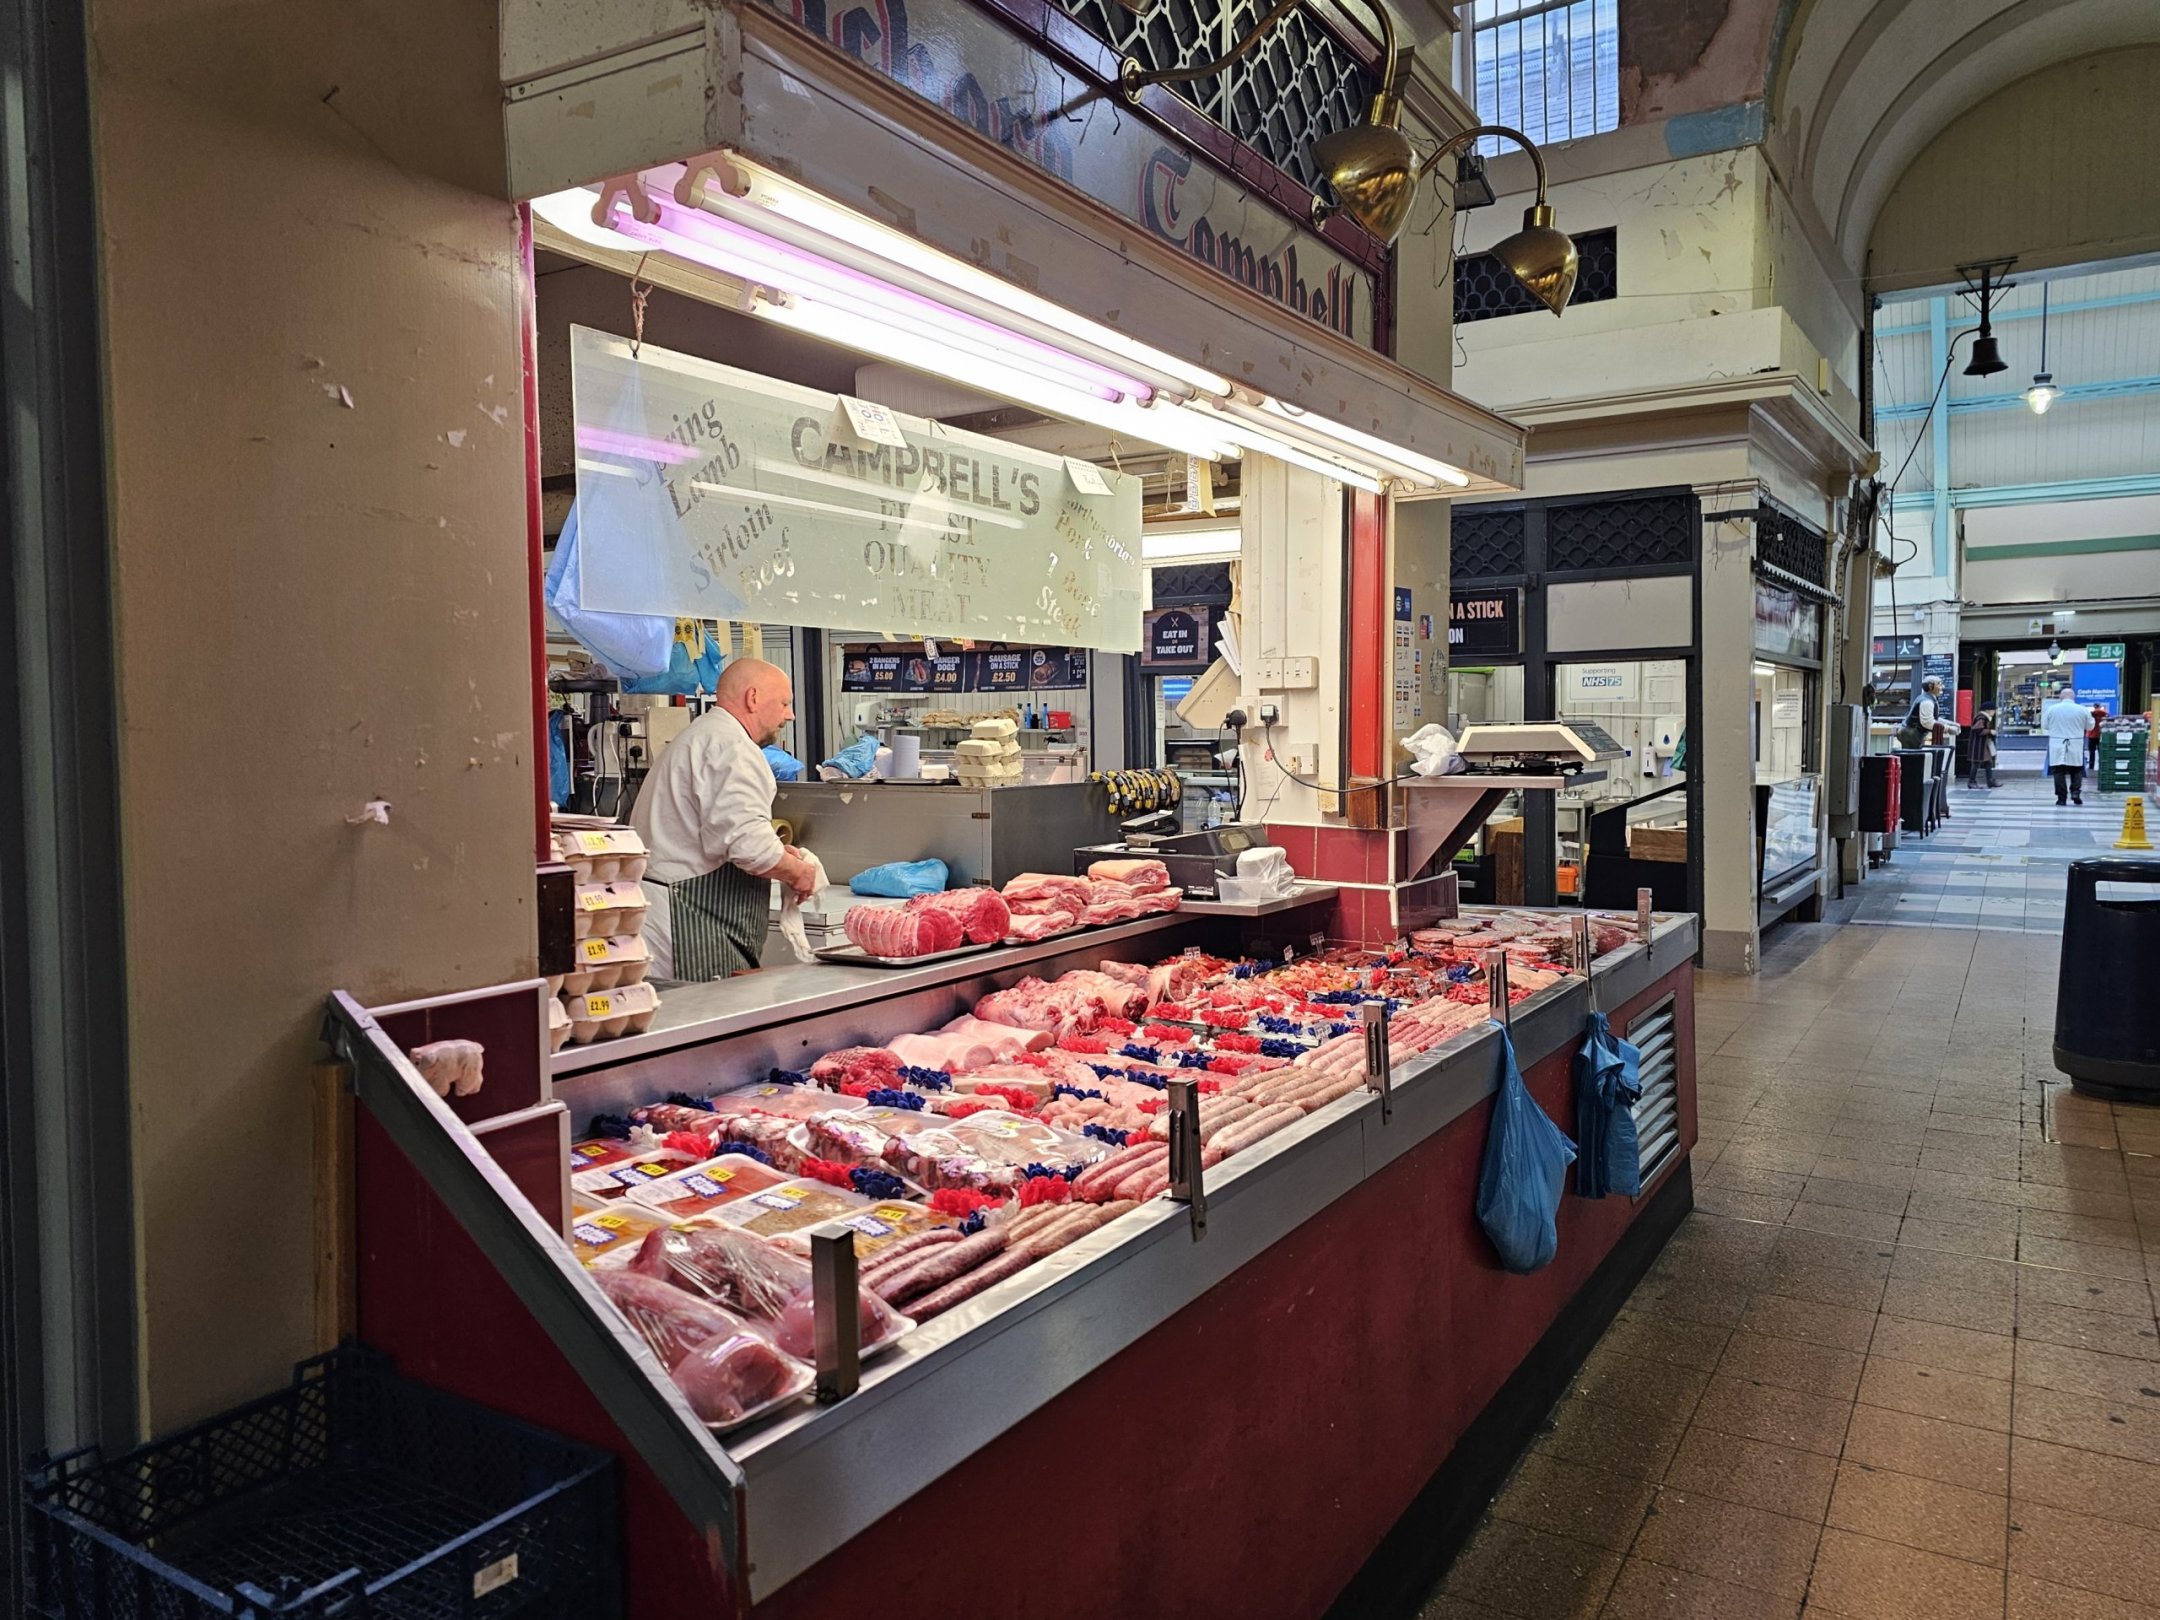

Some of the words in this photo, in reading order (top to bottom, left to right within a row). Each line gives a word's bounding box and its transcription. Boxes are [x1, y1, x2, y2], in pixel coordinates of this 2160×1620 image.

[636, 399, 723, 489] Spring
[790, 416, 1040, 516] CAMPBELL'S
[667, 434, 741, 520] Lamb
[879, 498, 978, 546] FIST
[690, 502, 774, 595] Sirloin
[1456, 602, 1465, 620] A
[1467, 600, 1504, 619] STICK
[1162, 630, 1178, 639] EAT
[1178, 630, 1188, 638] IN
[1156, 646, 1176, 654] TAKE
[1177, 645, 1194, 654] OUT
[988, 654, 1022, 662] SAUSAGE
[990, 662, 998, 670] ON
[1003, 661, 1020, 670] STICK
[934, 673, 957, 683] £4.00
[991, 672, 1016, 683] £2.50
[1583, 677, 1606, 686] NHS
[1609, 677, 1622, 686] 75
